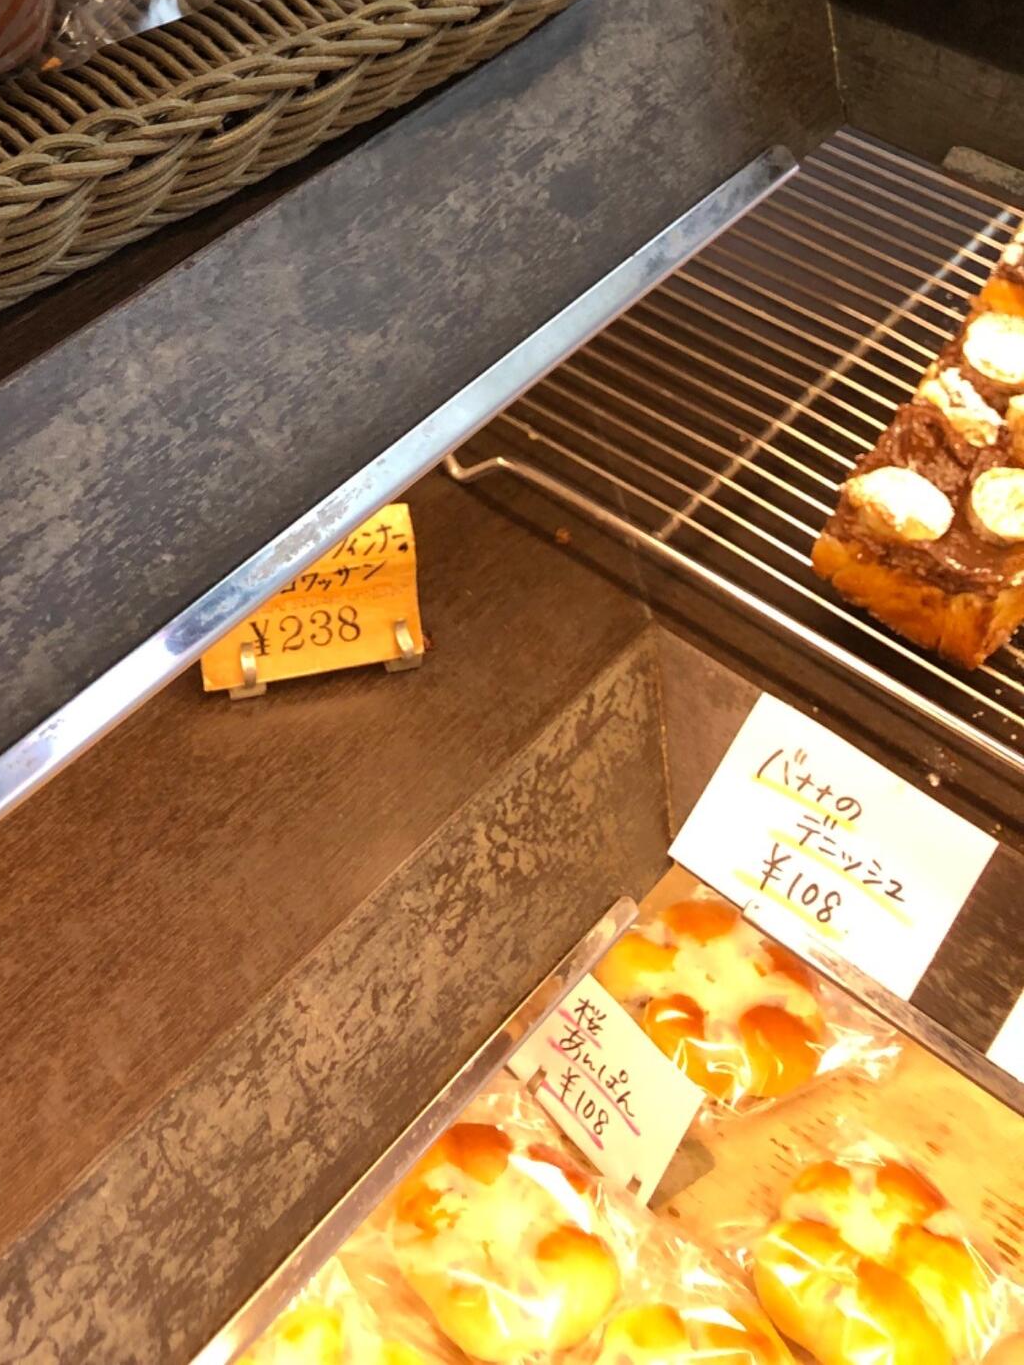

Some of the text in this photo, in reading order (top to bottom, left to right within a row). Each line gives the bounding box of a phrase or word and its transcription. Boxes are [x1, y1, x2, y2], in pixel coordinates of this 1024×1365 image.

[249, 605, 362, 658] ¥238
[756, 747, 863, 822] バナナの
[760, 842, 842, 923] ¥108
[796, 814, 906, 903] デニッシュ
[574, 997, 608, 1036] 桜
[559, 1024, 636, 1118] あんぱん
[560, 1067, 610, 1136] ¥108
